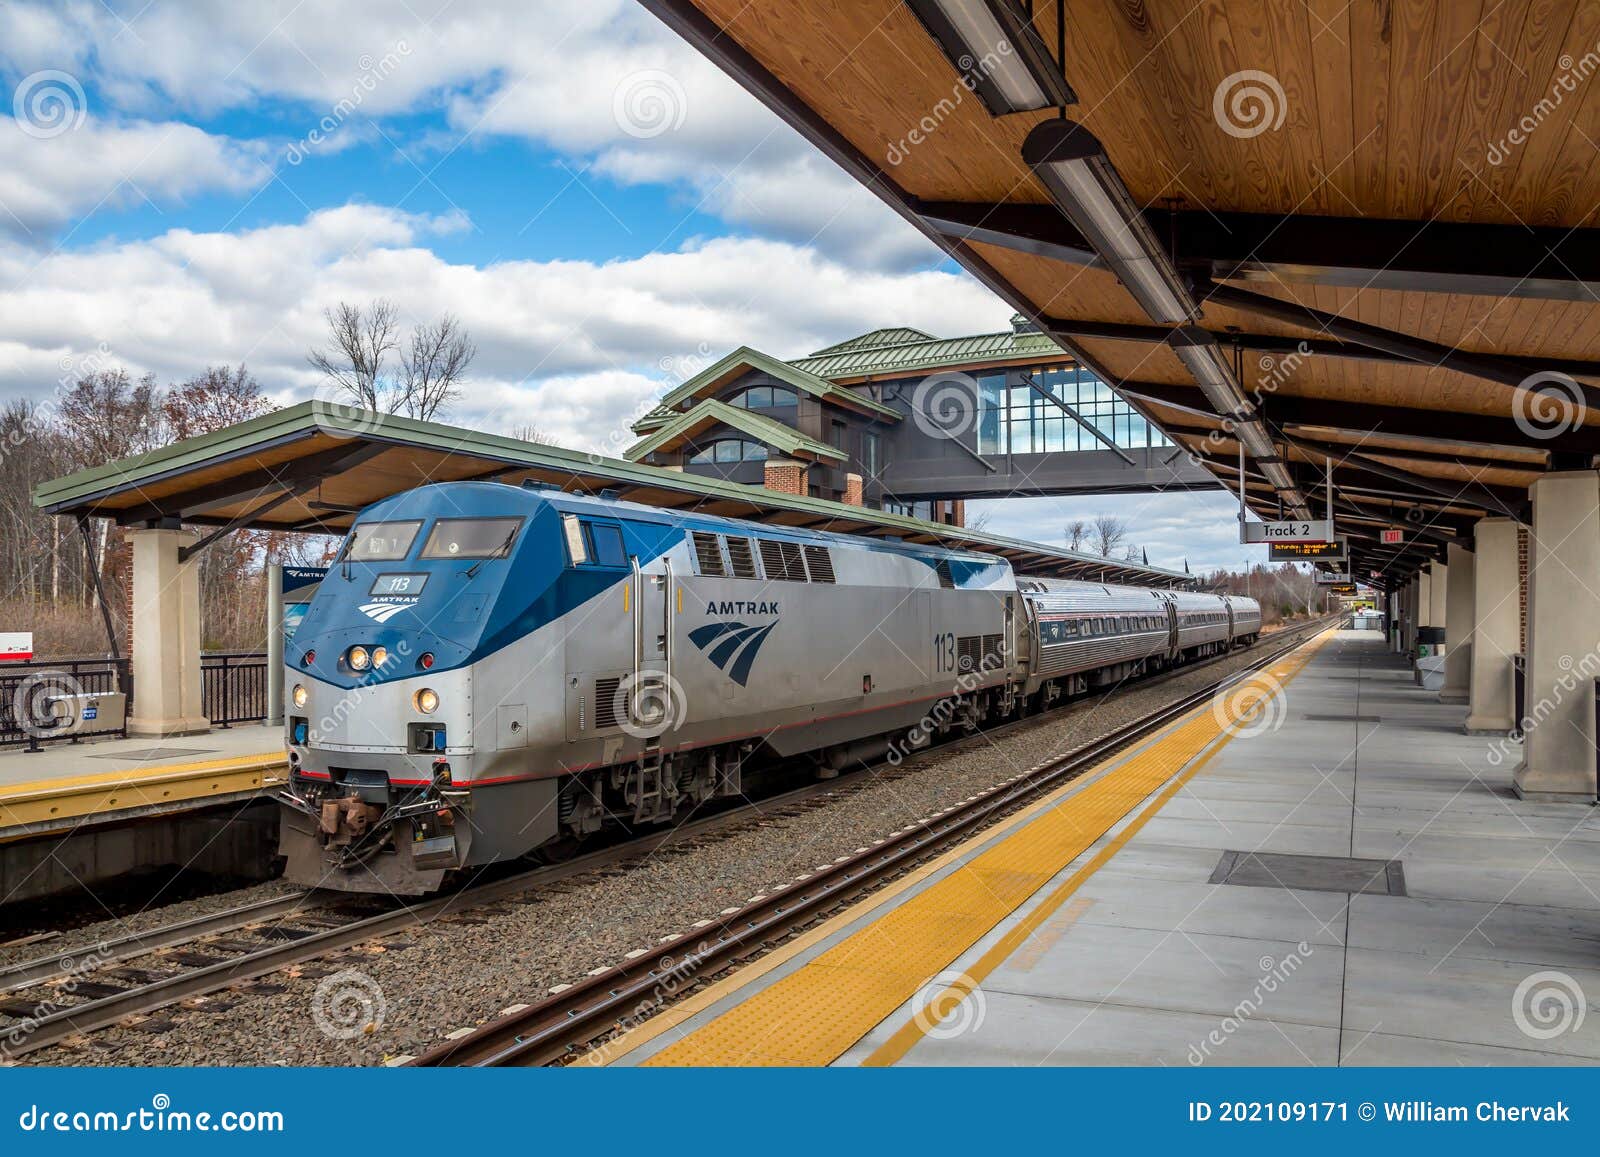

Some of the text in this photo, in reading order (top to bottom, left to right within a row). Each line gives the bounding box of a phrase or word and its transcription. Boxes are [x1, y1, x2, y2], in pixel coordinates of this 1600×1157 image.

[1263, 524, 1310, 536] Track 2
[1383, 531, 1401, 542] EXIT
[389, 578, 410, 591] 113
[706, 602, 779, 615] AMTRAK
[935, 632, 955, 673] 113
